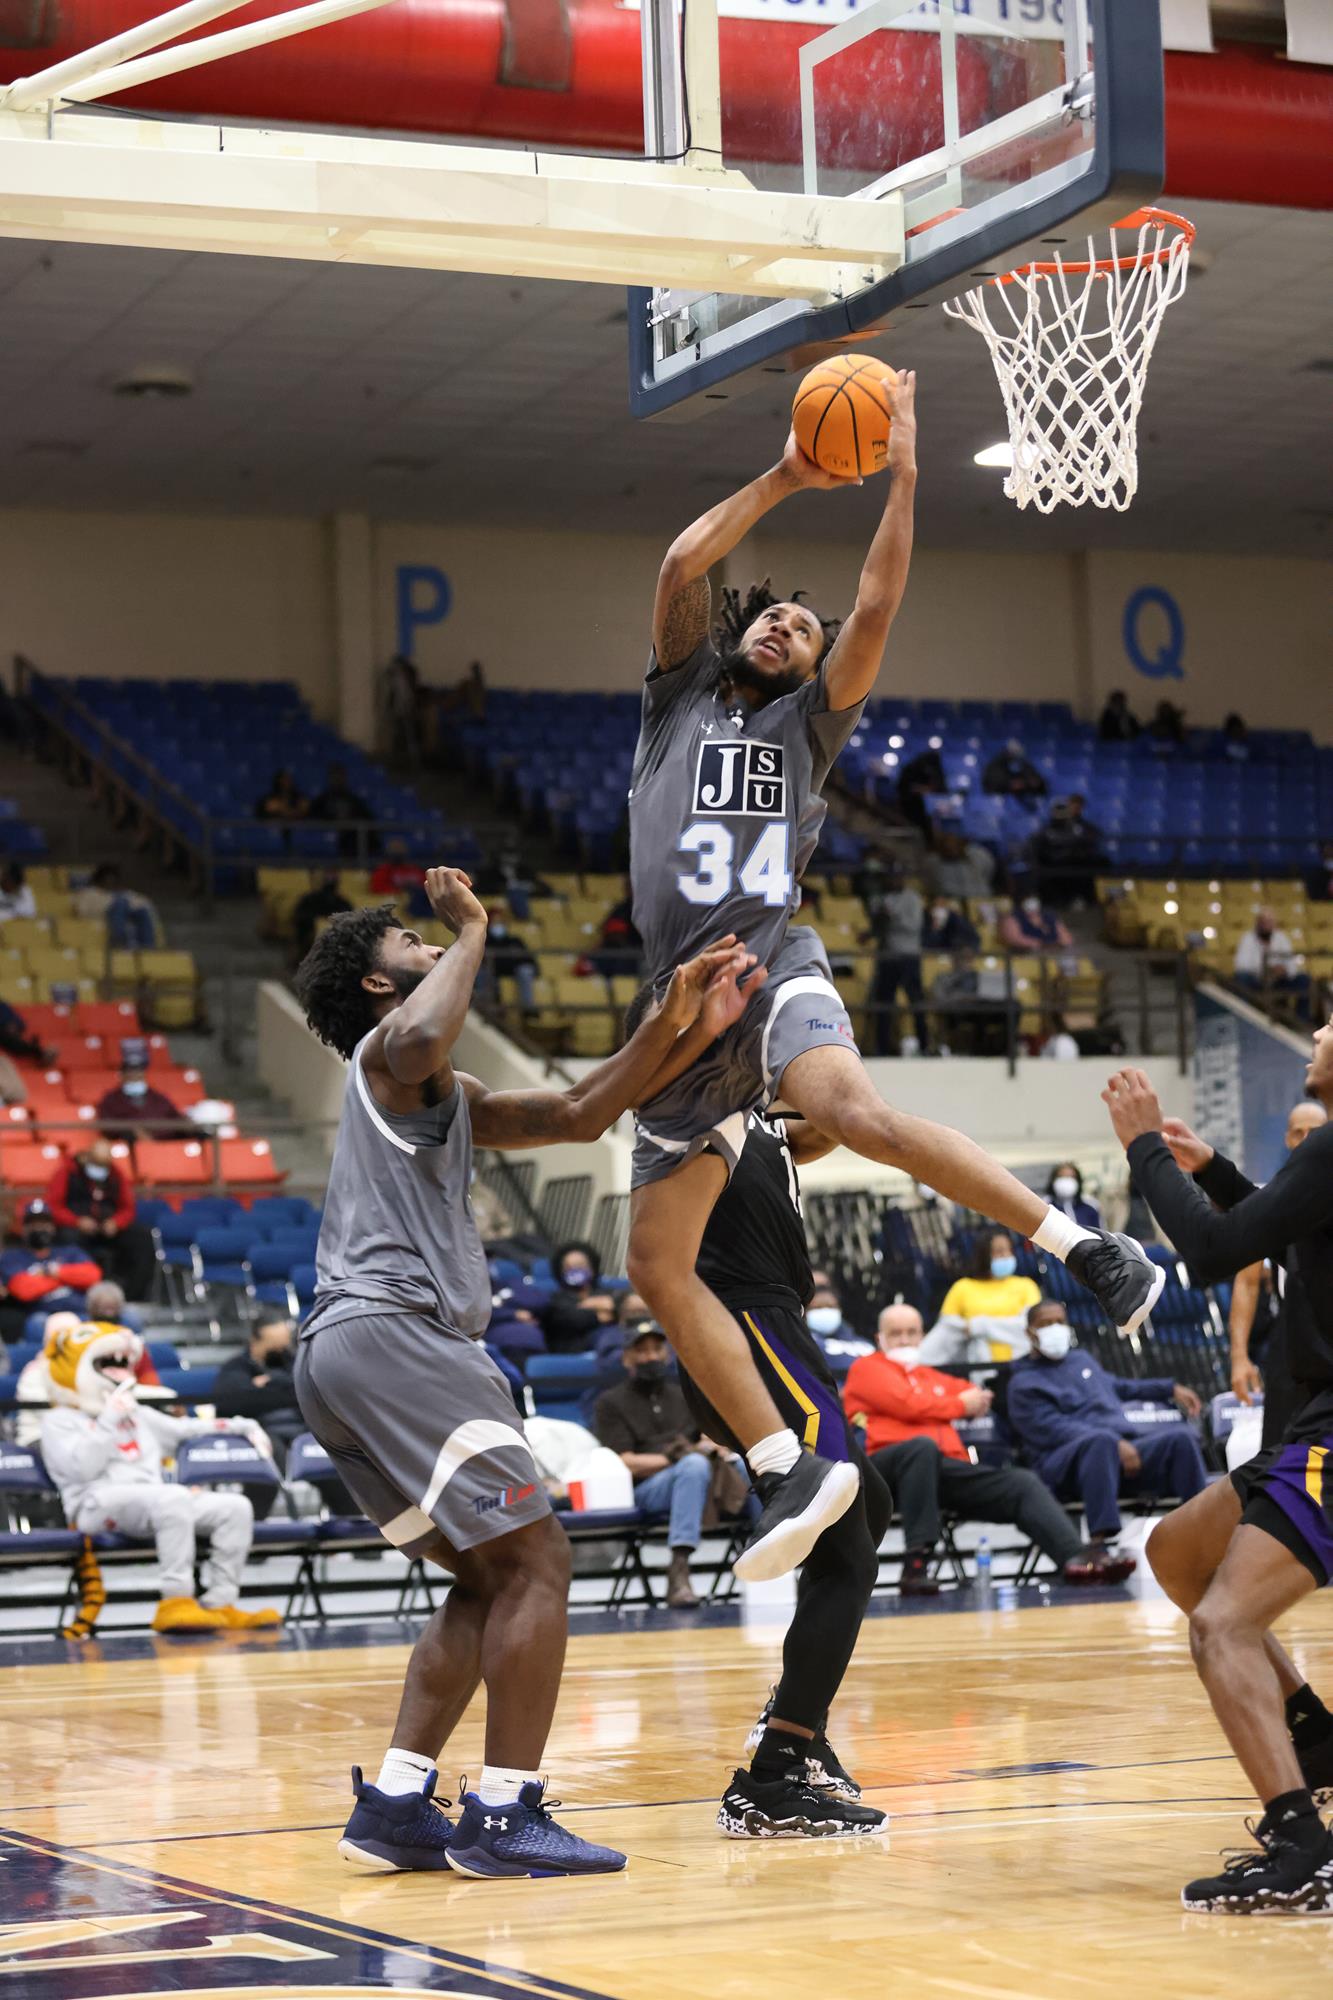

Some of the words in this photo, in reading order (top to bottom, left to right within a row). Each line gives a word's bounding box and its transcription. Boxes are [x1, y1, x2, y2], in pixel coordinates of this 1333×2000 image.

[396, 565, 453, 657] P
[1123, 584, 1185, 681] Q
[677, 820, 793, 907] 34
